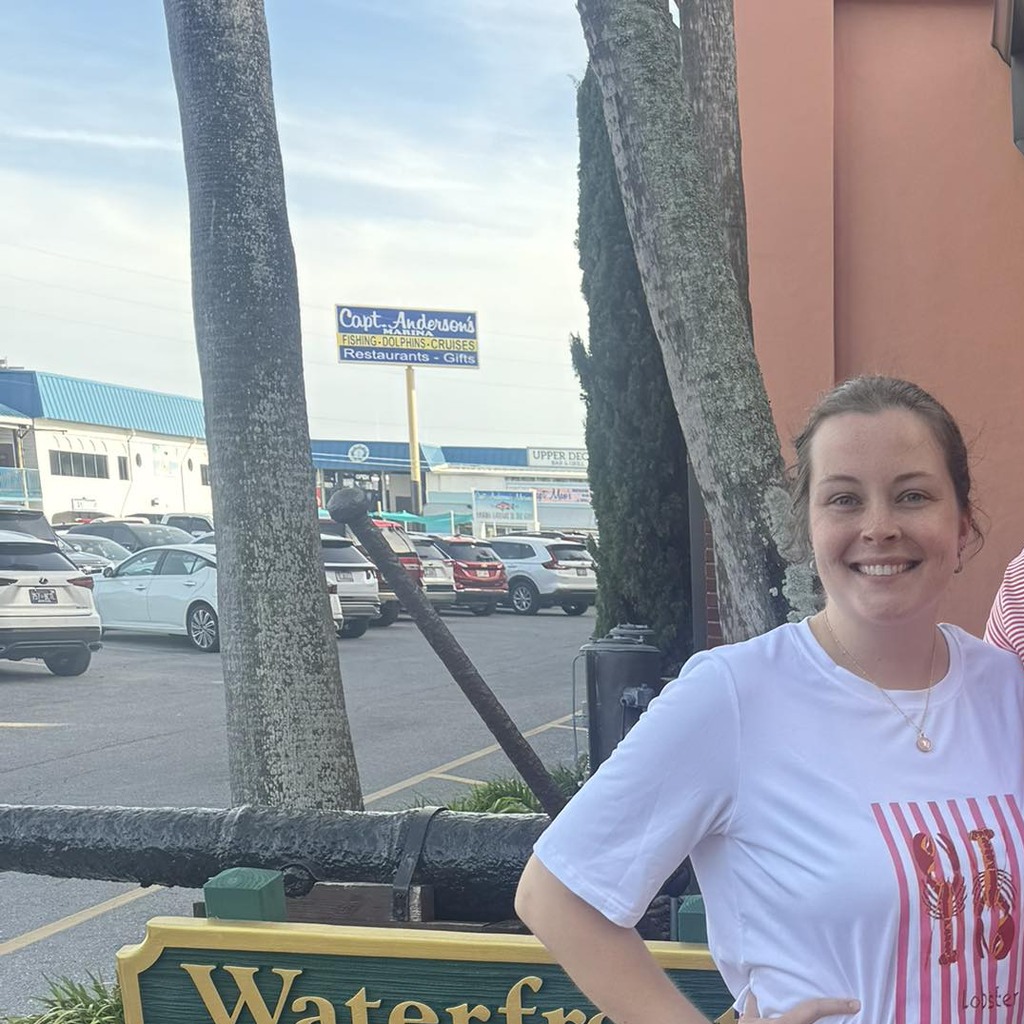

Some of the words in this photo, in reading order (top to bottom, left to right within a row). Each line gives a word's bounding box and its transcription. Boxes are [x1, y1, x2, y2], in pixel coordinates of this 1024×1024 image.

[388, 311, 475, 334] Anderson's
[343, 348, 430, 361] Restaurants
[443, 352, 476, 364] Gifts
[532, 450, 566, 460] UPPER
[568, 452, 589, 461] DEC
